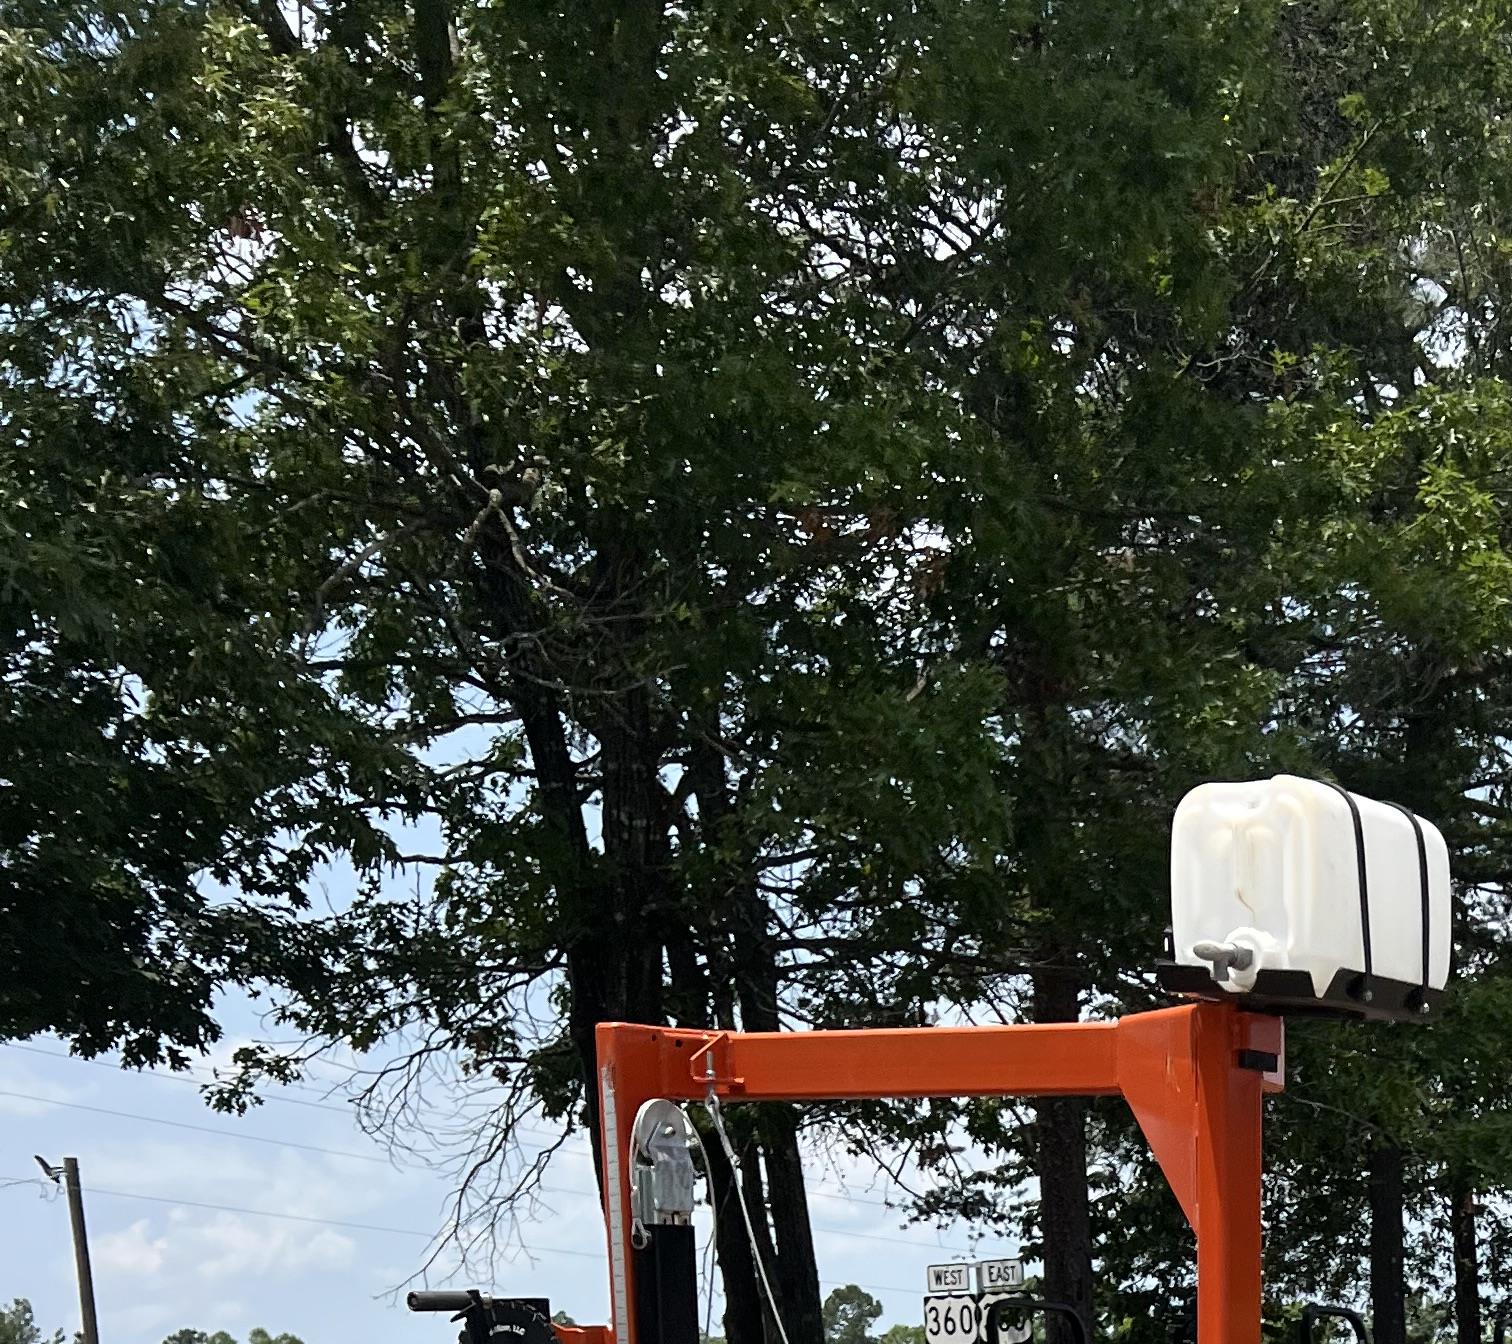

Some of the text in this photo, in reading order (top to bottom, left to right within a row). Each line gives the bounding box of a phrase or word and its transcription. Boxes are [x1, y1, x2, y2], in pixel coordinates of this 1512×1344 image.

[933, 1270, 963, 1285] WEST
[988, 1265, 1016, 1282] EAST
[928, 1304, 973, 1336] 360
